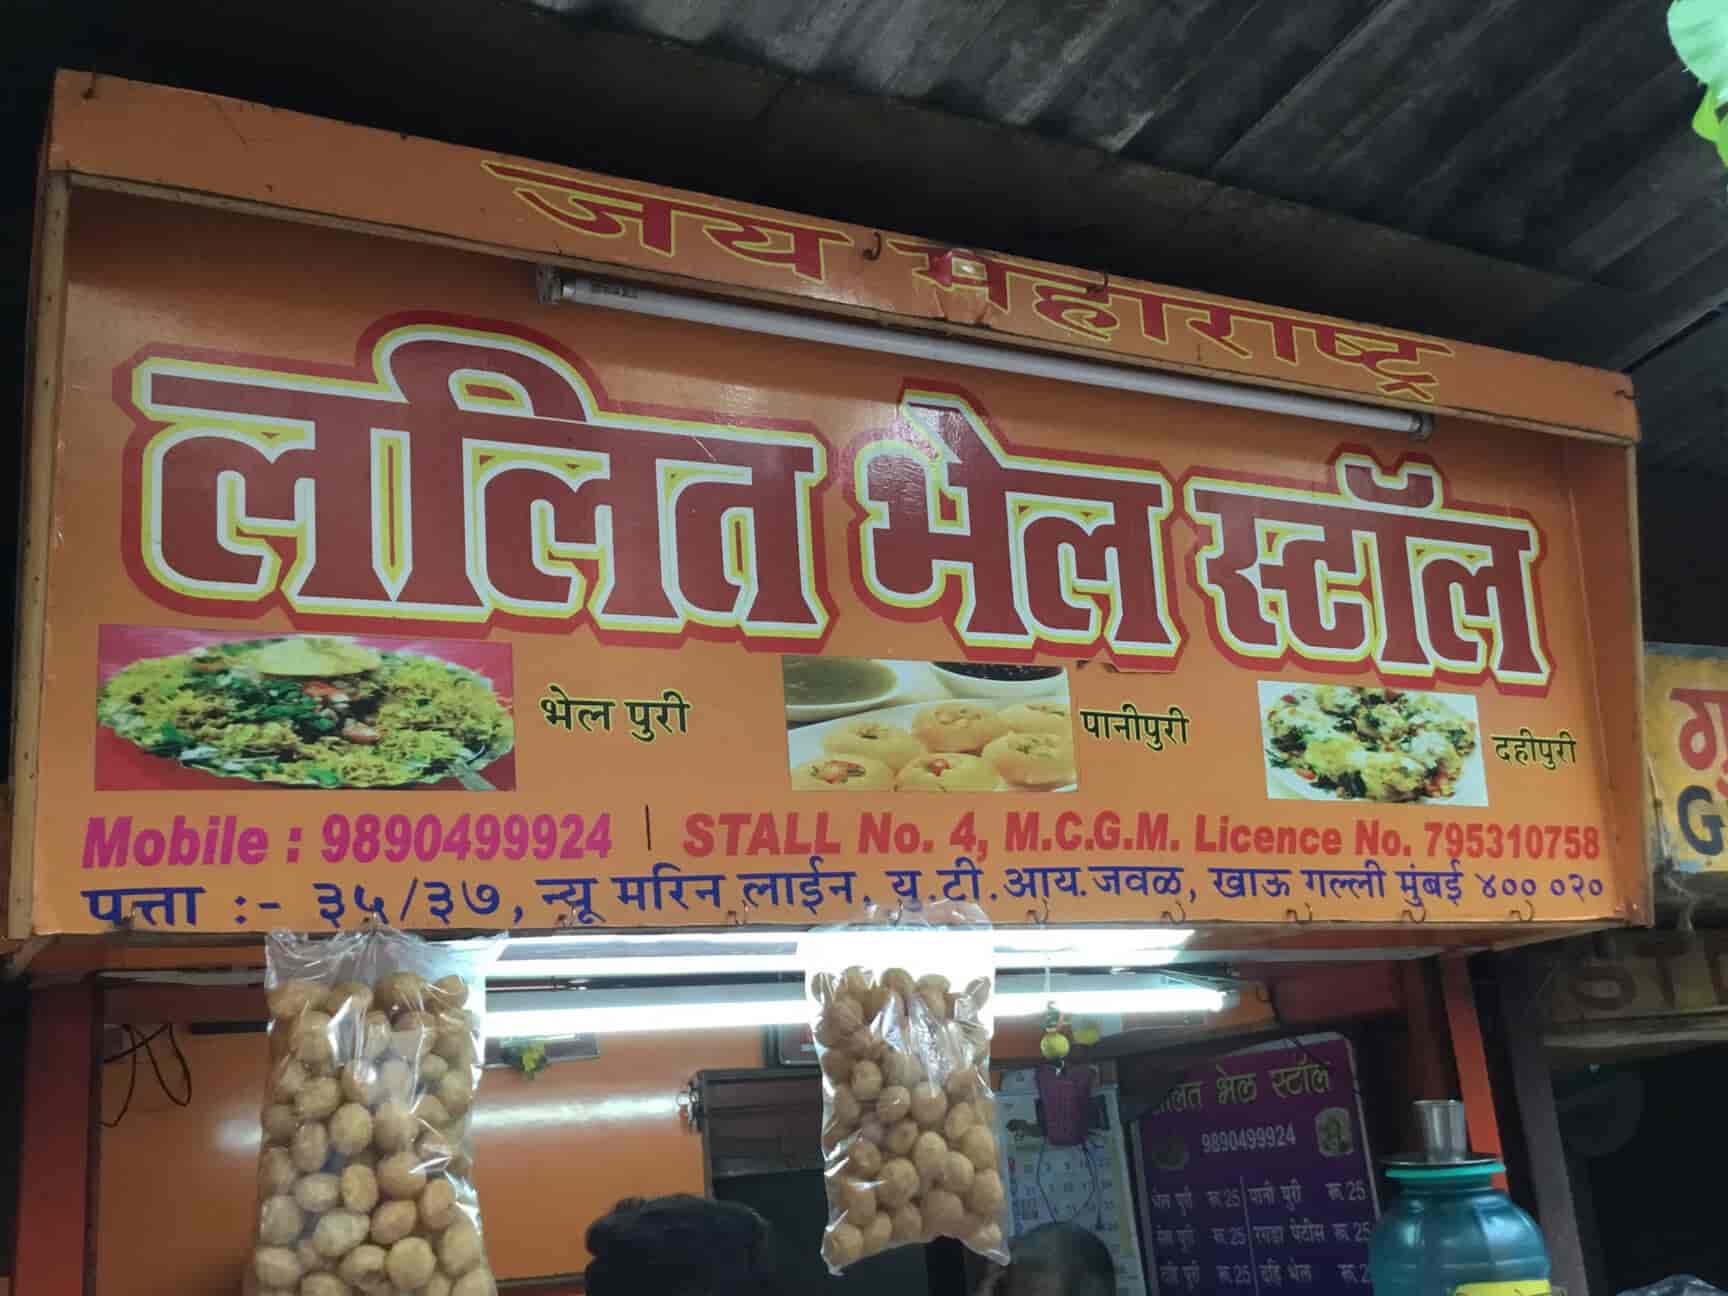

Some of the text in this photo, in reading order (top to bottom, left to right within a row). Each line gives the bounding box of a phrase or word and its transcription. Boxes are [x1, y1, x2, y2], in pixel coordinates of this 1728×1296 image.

[480, 160, 1455, 402] जय महाराष्ट्र
[125, 318, 1553, 684] ललित भेल स्टॉल
[540, 683, 692, 743] भेल पुरी
[1079, 702, 1191, 753] पानीपुरी
[1490, 727, 1577, 770] दहीपुरी
[81, 814, 268, 869] Mobile
[320, 812, 613, 864] 9890499924
[682, 810, 1601, 863] STALL No. 4, M.C.G.M. Licence No. 795310758
[80, 885, 207, 927] पत्ता
[535, 877, 607, 925] न्यू
[610, 862, 726, 912] मरिन
[1207, 867, 1293, 898] खाऊ
[1299, 859, 1387, 900] गल्ली
[1393, 858, 1464, 908] मुंबई
[1473, 872, 1538, 899] ४००
[1549, 872, 1605, 903] ०२०
